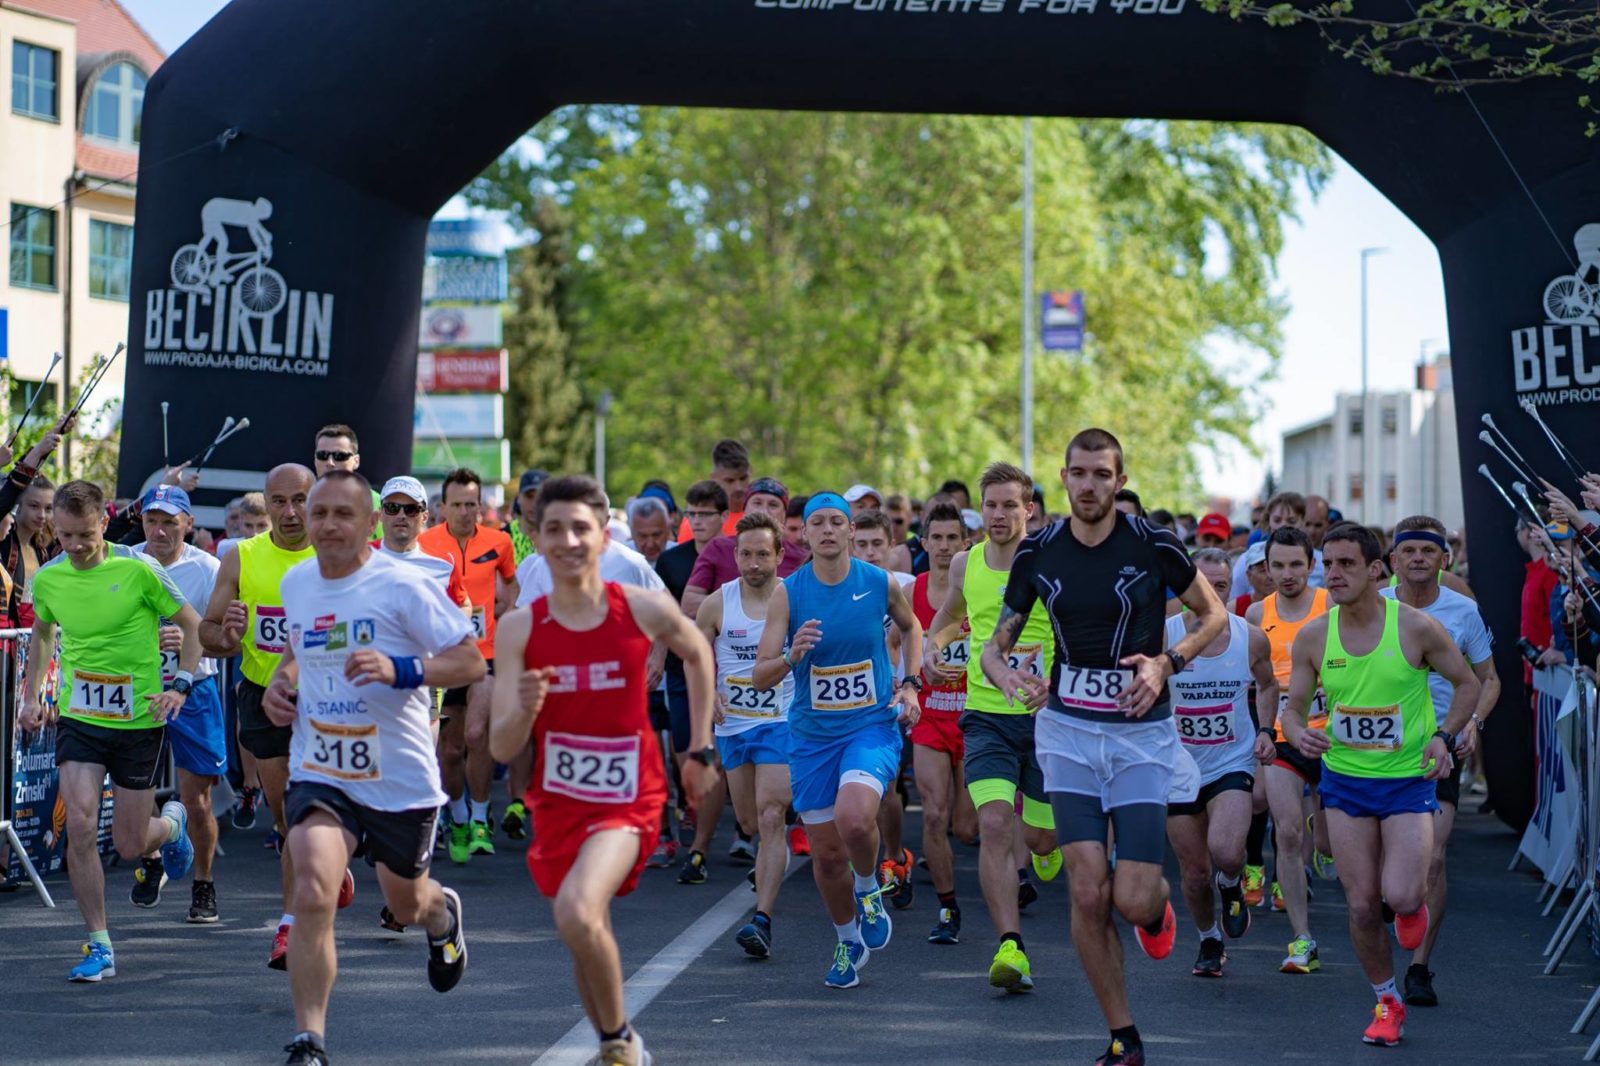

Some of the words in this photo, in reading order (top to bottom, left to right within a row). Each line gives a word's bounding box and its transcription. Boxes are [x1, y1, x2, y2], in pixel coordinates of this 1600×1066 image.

[1017, 0, 1097, 14] FOR
[1109, 0, 1186, 14] YOU
[144, 284, 334, 360] BECIKLIN
[144, 351, 328, 376] WWW.PRODAJA-BICIKLA.COM
[260, 617, 288, 642] 69
[943, 643, 969, 662] 94
[816, 674, 868, 701] 285
[1067, 665, 1123, 699] 758
[1175, 680, 1217, 690] ATLETSKI
[1219, 680, 1242, 688] KLUB
[81, 682, 127, 709] 114
[729, 685, 776, 708] 232
[925, 697, 966, 711] DUBROV
[1181, 689, 1237, 701] VARAŽDIN
[1180, 715, 1230, 738] 833
[1340, 716, 1395, 740] 182
[16, 748, 56, 772] Polumara
[314, 734, 371, 770] 318
[556, 750, 628, 787] 825
